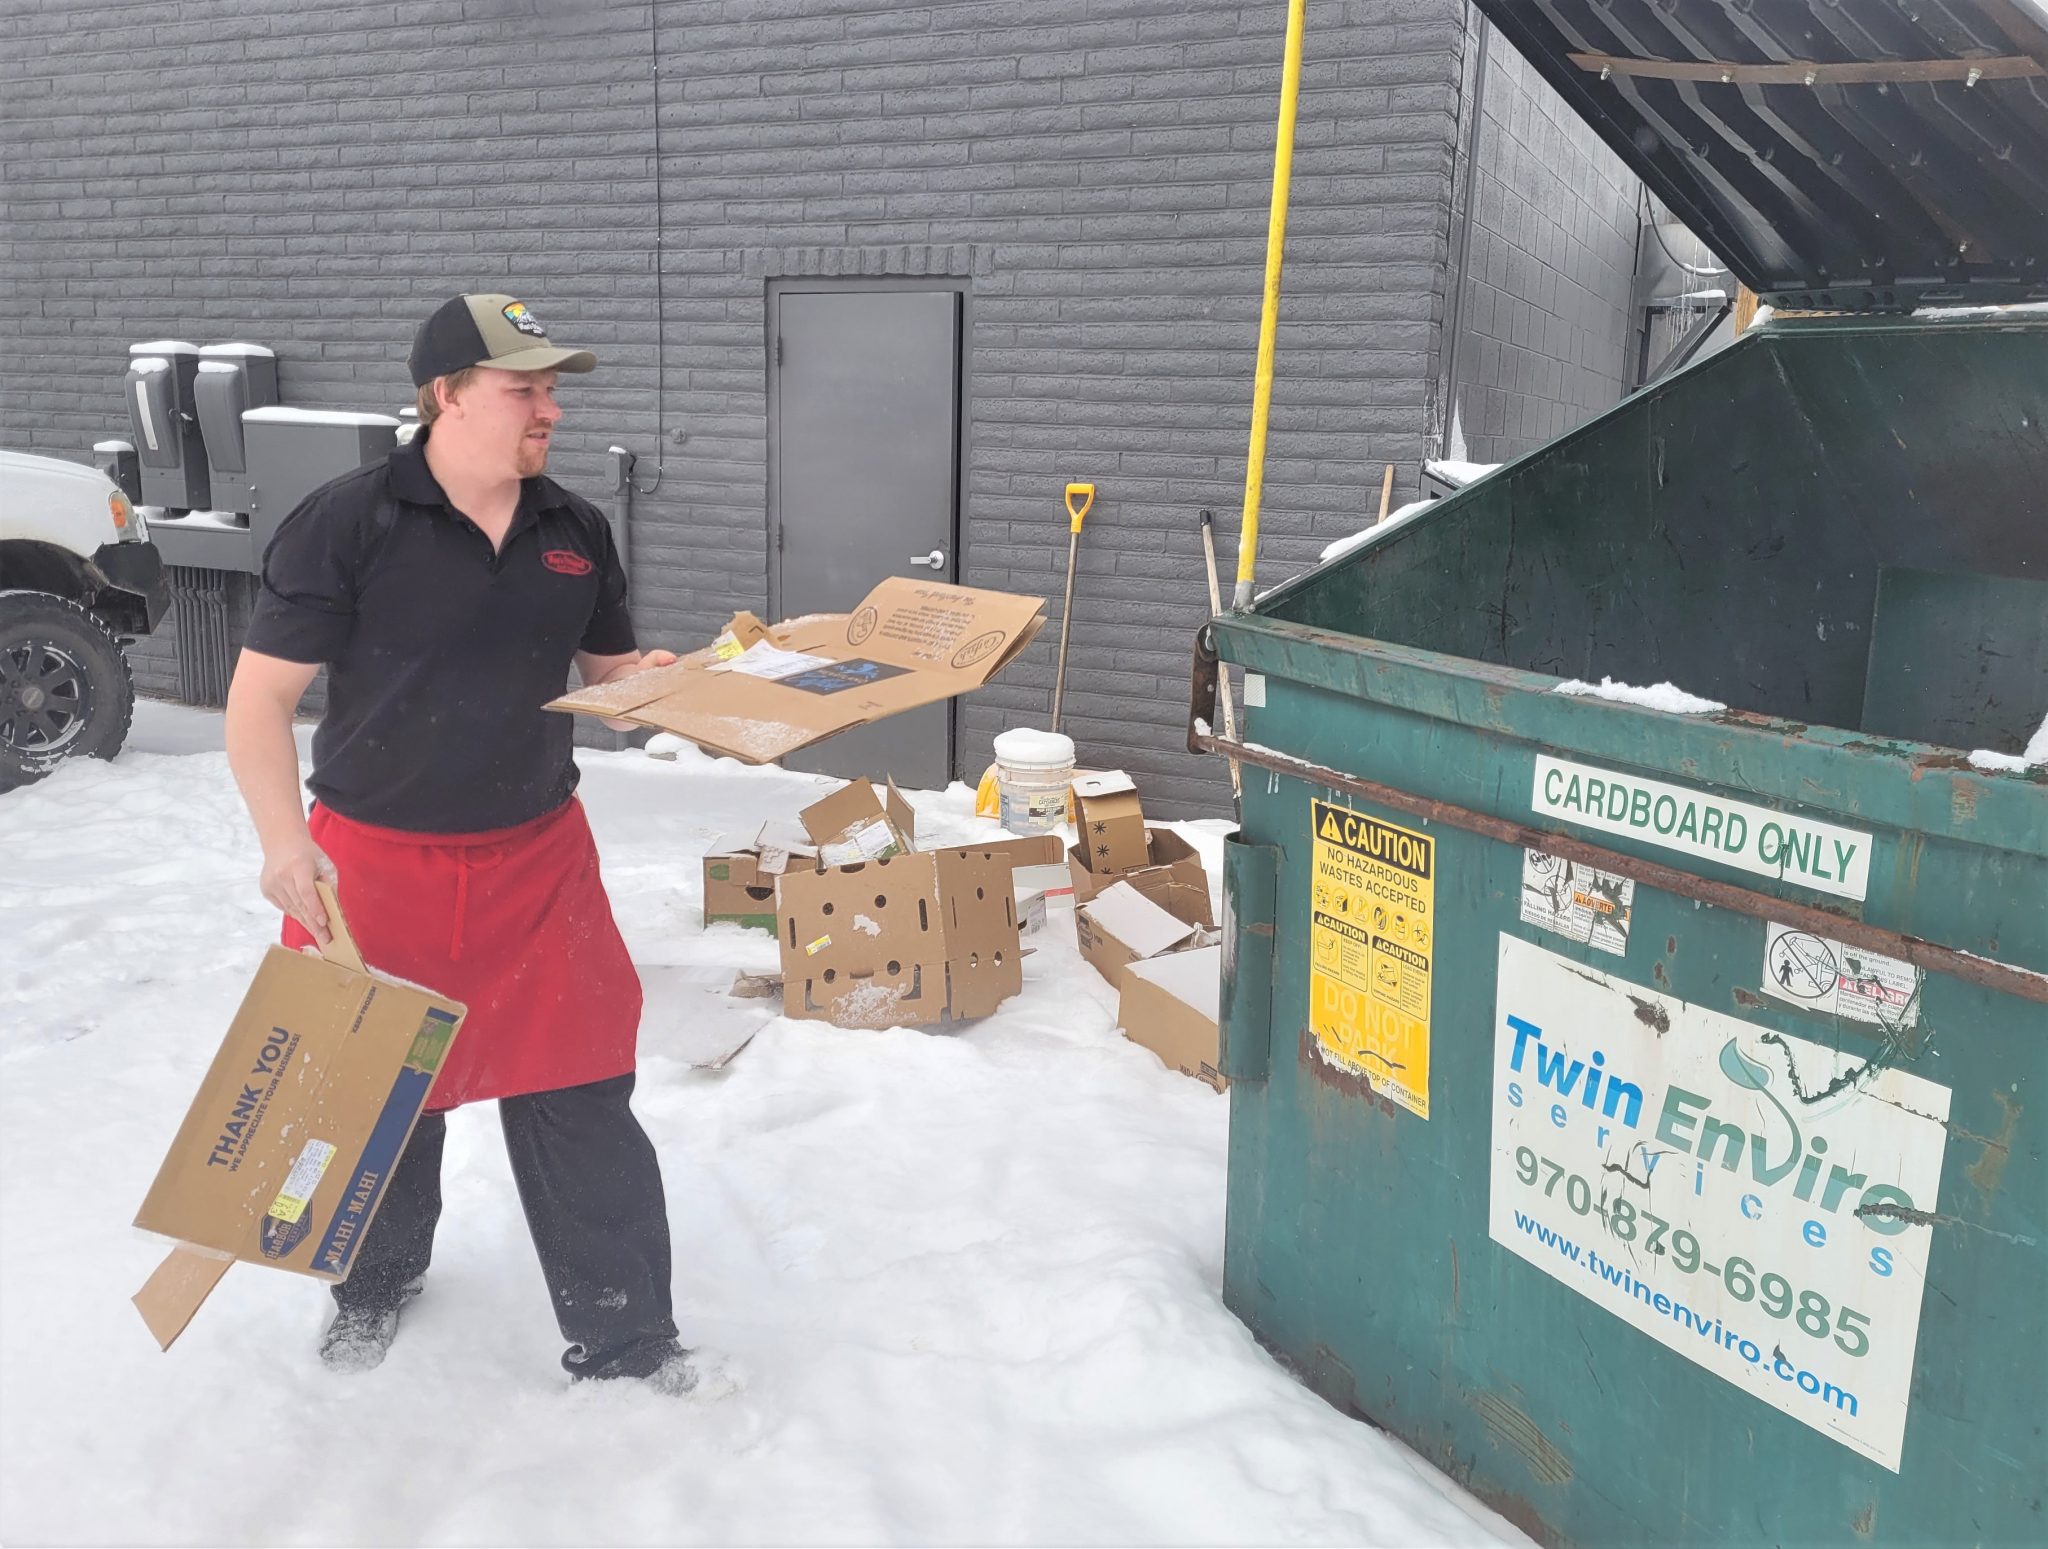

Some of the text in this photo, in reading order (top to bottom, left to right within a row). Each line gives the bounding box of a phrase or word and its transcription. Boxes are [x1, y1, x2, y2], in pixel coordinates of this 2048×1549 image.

[1344, 817, 1425, 873] CAUTION
[1544, 768, 1857, 884] CARDBOARD ONLY
[1320, 861, 1426, 914] WASTES ACCEPTED
[1327, 846, 1418, 892] NO HAZARDOUS
[1323, 915, 1366, 942] CAUTION
[1524, 900, 1547, 915] FALLING
[1382, 942, 1426, 969] CAUTION
[1325, 977, 1357, 1020] DO
[1365, 1001, 1415, 1049] NOT
[1340, 1022, 1398, 1080] PARK
[1506, 1014, 1644, 1129] Twin
[206, 1026, 290, 1167] THANK YOU
[1334, 1053, 1346, 1065] FILL
[1347, 1059, 1368, 1078] ABOVE
[1369, 1071, 1381, 1082] TOP
[1382, 1078, 1390, 1087] OF
[1391, 1082, 1427, 1108] CONTAINER
[228, 1155, 242, 1173] WE
[239, 1103, 268, 1157] APPRECIATE
[263, 1079, 281, 1102] YOUR
[266, 1222, 292, 1259] HARBOR
[323, 1169, 379, 1263] MAHI-MAHI
[1514, 1145, 1872, 1358] 970-879-6985
[1514, 1208, 1858, 1418] www.twinenviro.com
